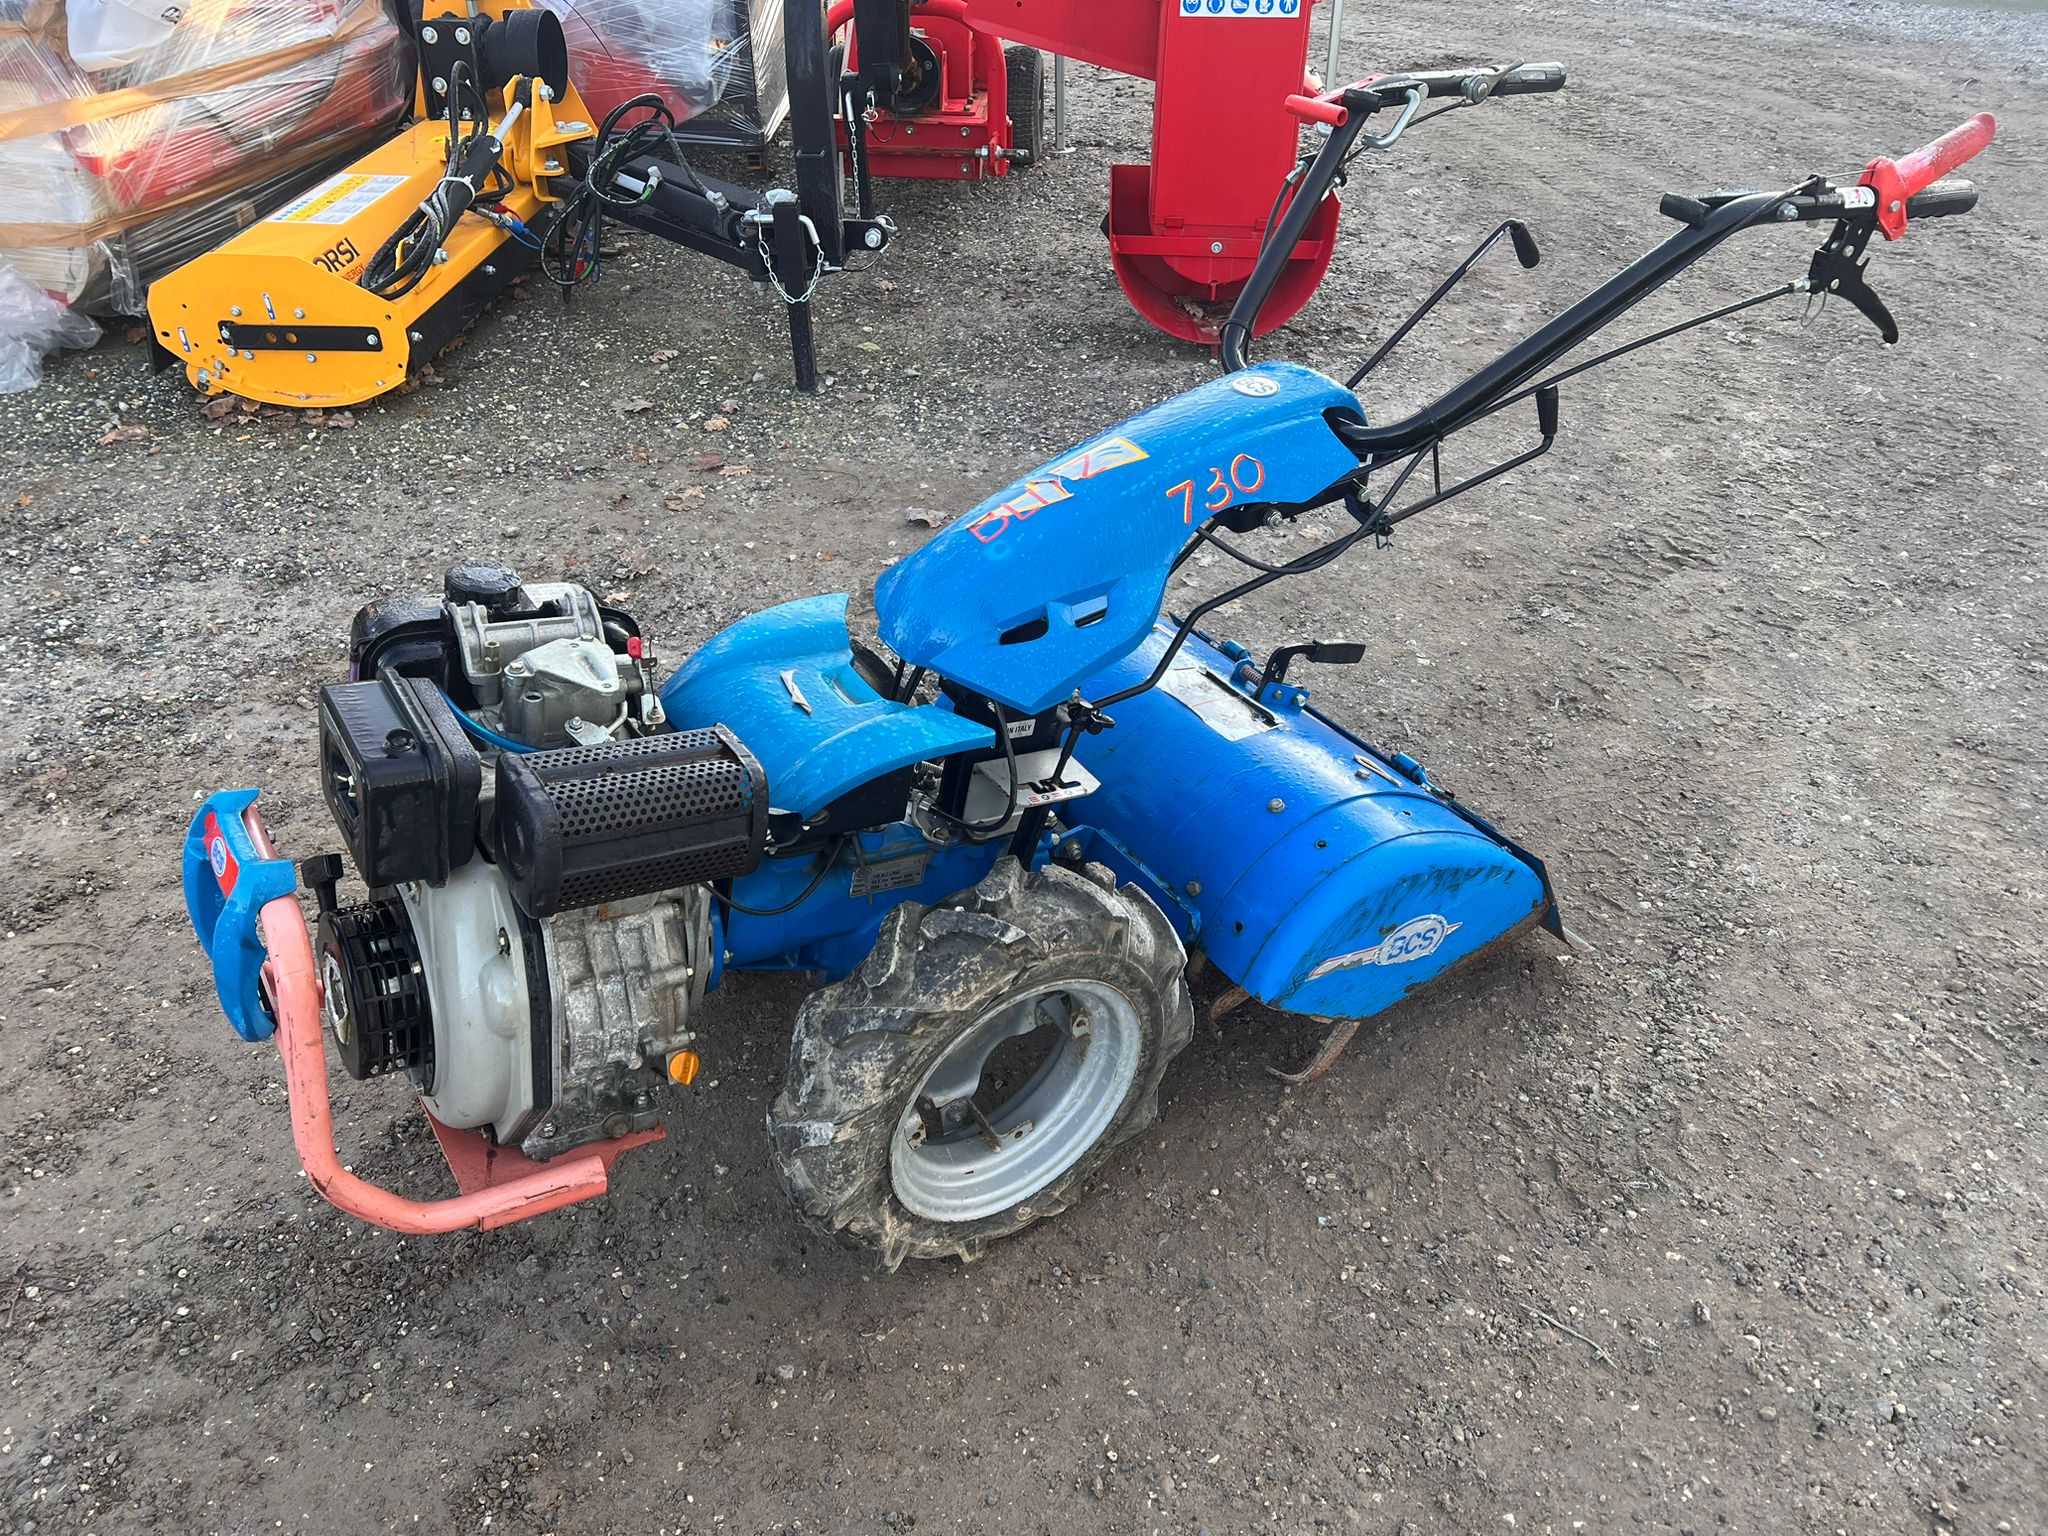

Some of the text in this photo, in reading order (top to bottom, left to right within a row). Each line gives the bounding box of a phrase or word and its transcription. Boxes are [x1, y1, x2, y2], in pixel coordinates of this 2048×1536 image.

[1235, 377, 1274, 395] BCS
[1165, 453, 1265, 525] 730
[1014, 723, 1033, 733] ITALY
[1386, 927, 1438, 961] BCS
